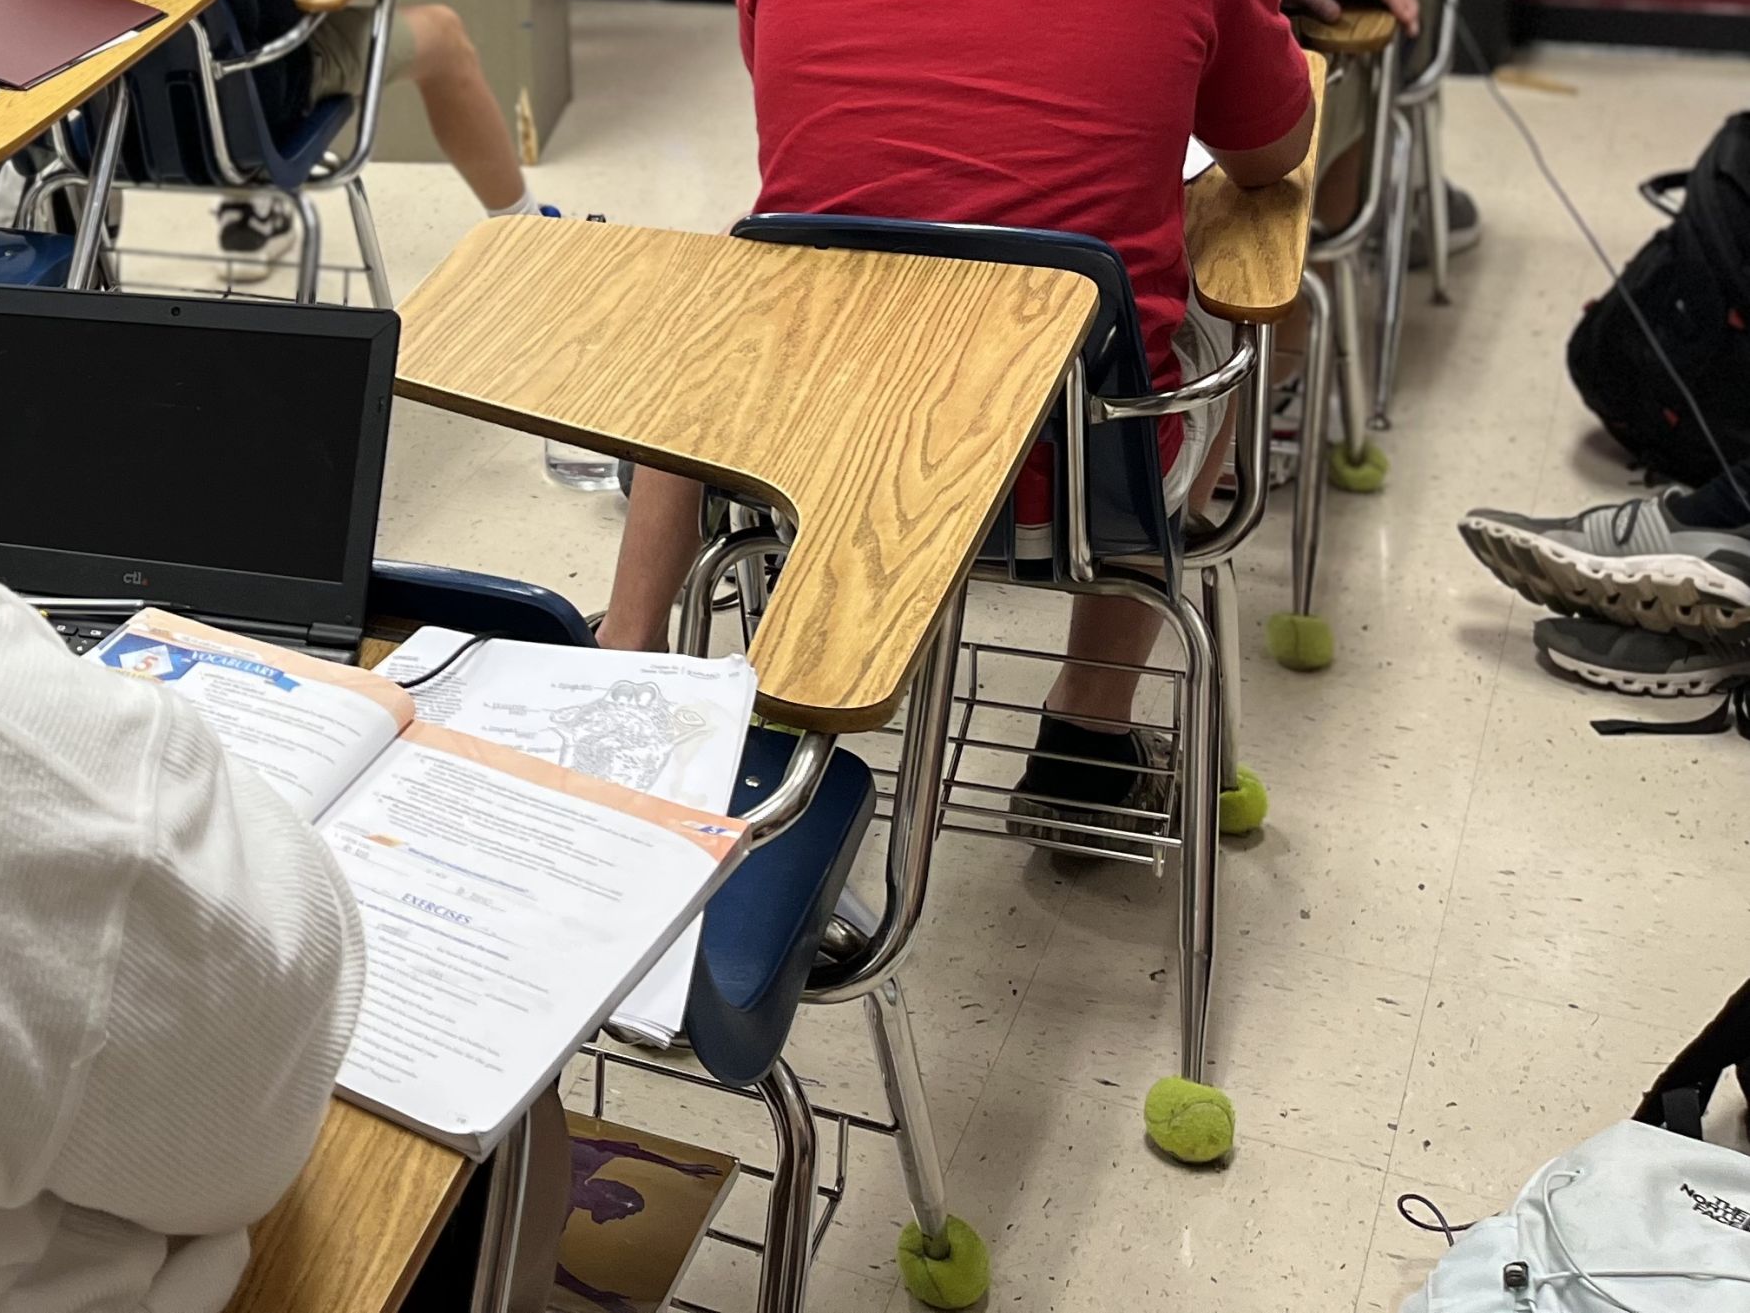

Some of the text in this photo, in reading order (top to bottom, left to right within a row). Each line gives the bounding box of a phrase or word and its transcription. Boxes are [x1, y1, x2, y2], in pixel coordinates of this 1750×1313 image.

[190, 650, 278, 679] VOCABULARY
[401, 892, 473, 926] EXERCISES
[1680, 1183, 1746, 1223] NORTH
[1714, 1196, 1750, 1220] THE
